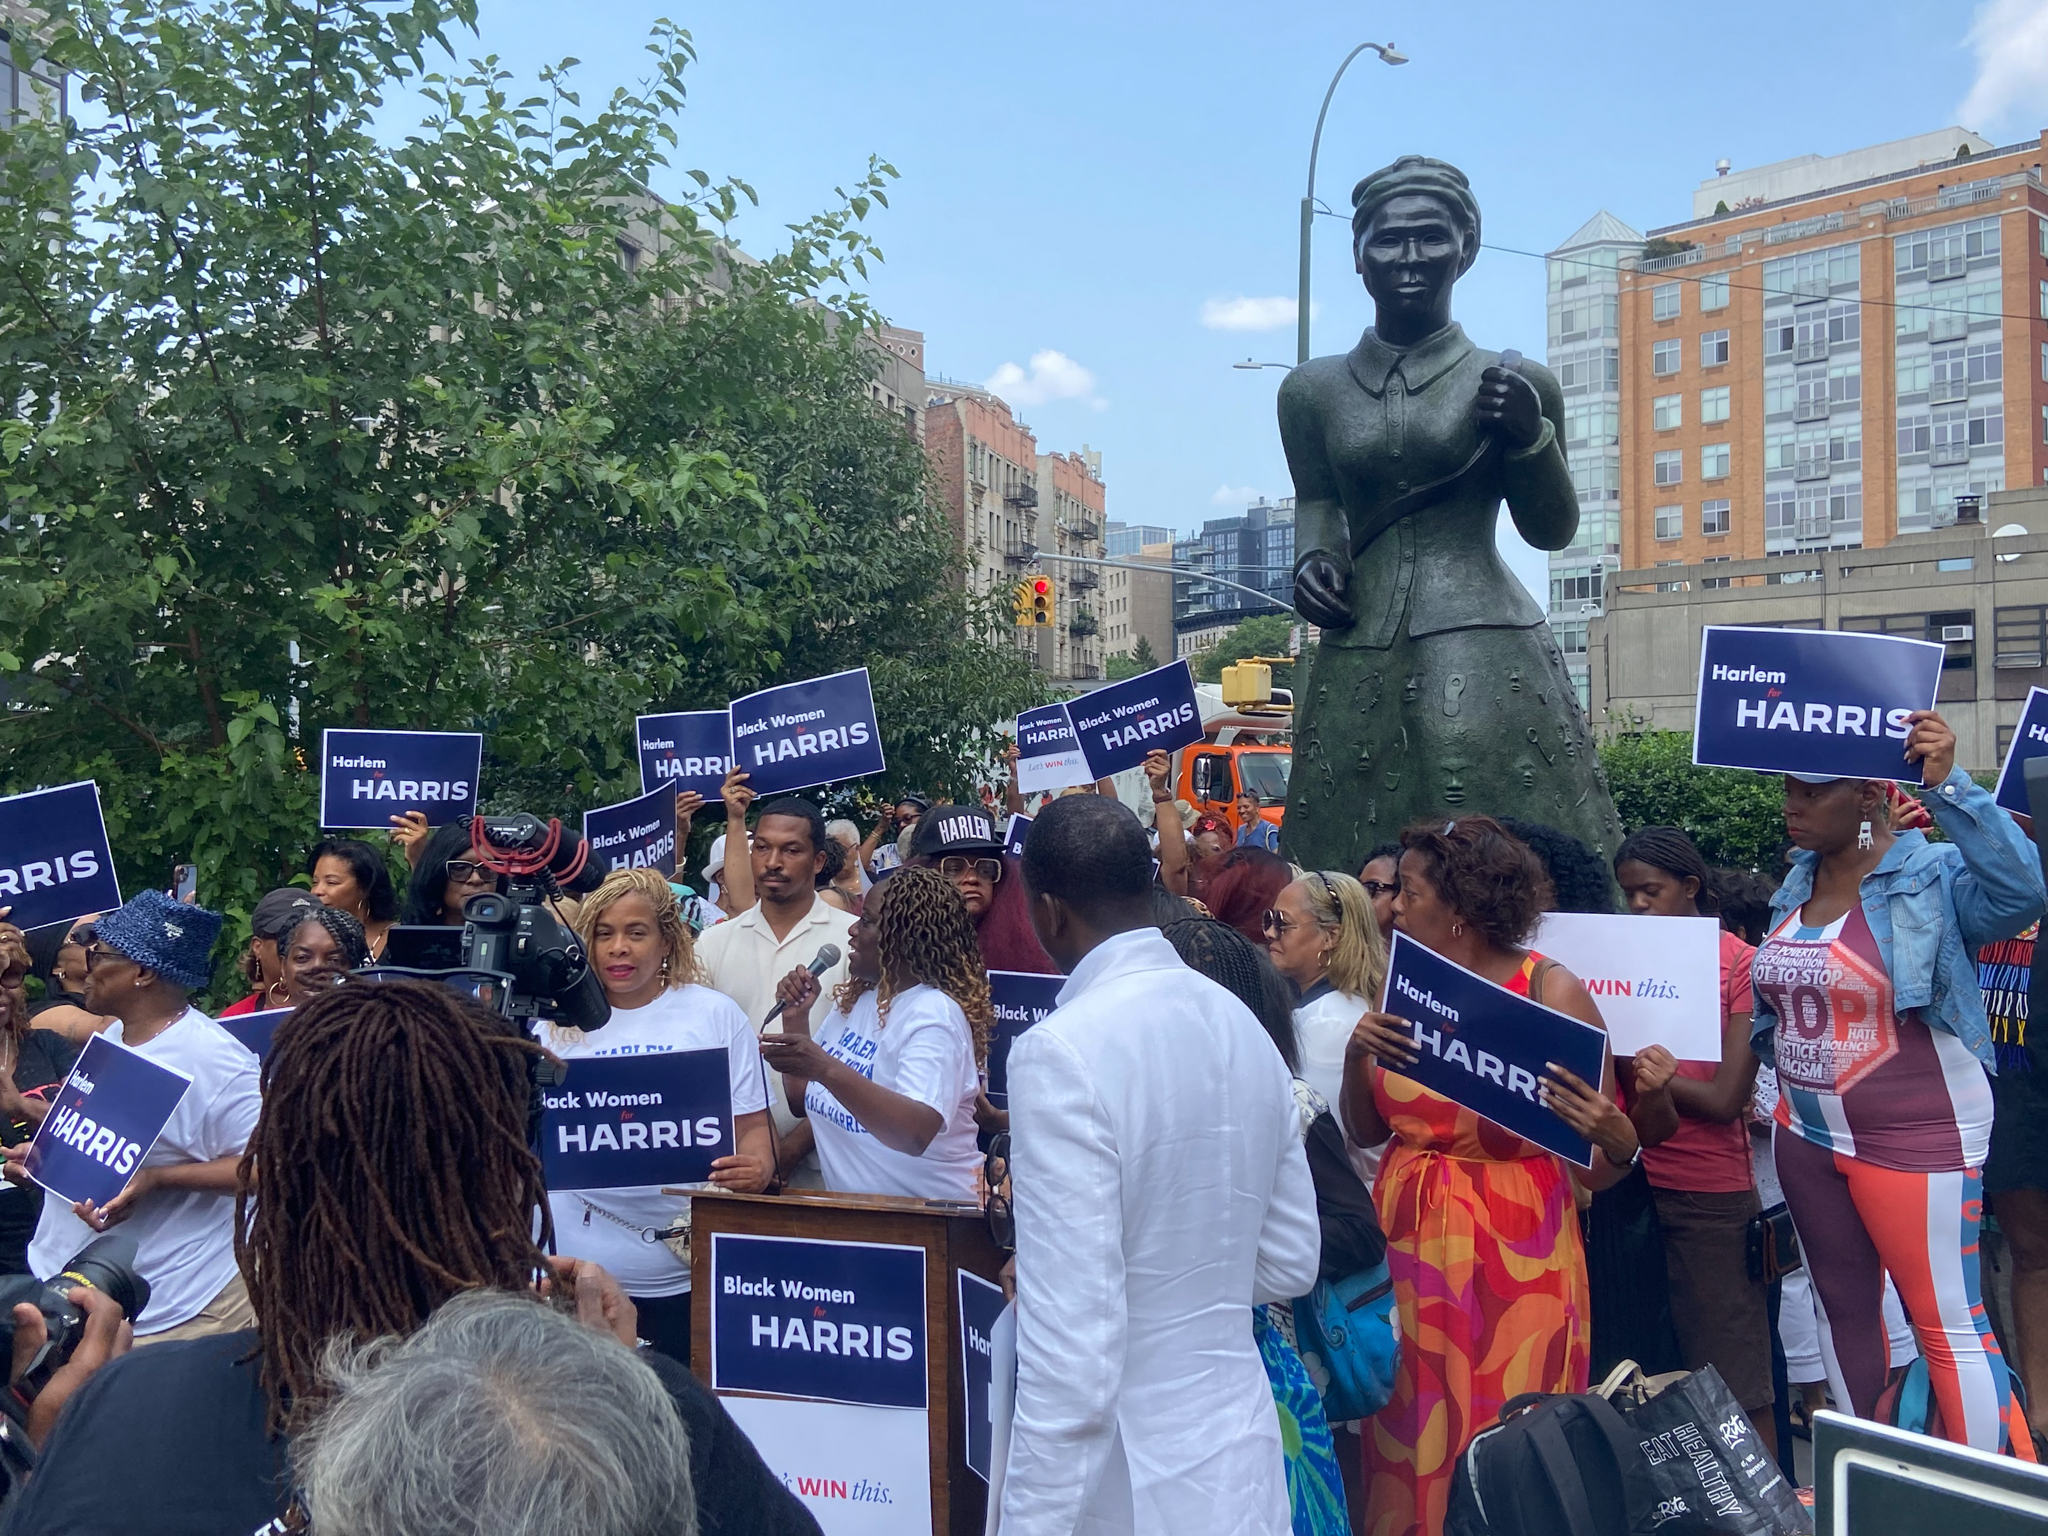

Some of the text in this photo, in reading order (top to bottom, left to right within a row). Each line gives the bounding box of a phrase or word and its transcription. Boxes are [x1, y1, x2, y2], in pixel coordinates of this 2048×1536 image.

[1712, 664, 1786, 684] Harlem
[1767, 688, 1782, 698] for
[736, 709, 826, 738] Black Women
[1035, 717, 1062, 727] Women
[1078, 697, 1160, 731] Black Women
[1736, 699, 1916, 740] HARRIS
[1026, 726, 1074, 745] HARRI
[1101, 702, 1194, 751] HARRIS
[642, 738, 675, 750] Harlem
[754, 722, 870, 766] HARRIS
[332, 755, 387, 768] Harlem
[655, 756, 731, 778] HARRI
[1028, 757, 1080, 772] Let's WIN this.
[352, 779, 469, 801] HARRIS
[592, 819, 661, 850] Black Women
[938, 815, 992, 845] HARLEM
[611, 830, 674, 872] HARRIS
[1758, 954, 1826, 968] SCRIMINATION
[1777, 946, 1821, 958] POVERTY
[1777, 966, 1798, 983] TO
[1800, 968, 1843, 986] STOP
[1837, 983, 1870, 991] INEQUITY
[1396, 973, 1460, 1023] Harlem
[1580, 978, 1680, 999] WIN this.
[993, 1004, 1029, 1021] Black
[1802, 1006, 1818, 1015] FEAR
[1848, 1028, 1878, 1040] HATE
[1819, 1050, 1860, 1058] EXPLOITATION
[1821, 1040, 1870, 1052] VIOLENCE
[1413, 1020, 1551, 1109] HARR
[1779, 1056, 1823, 1079] RACISM
[68, 1069, 95, 1096] Harlem
[542, 1091, 663, 1109] lack Women
[620, 1110, 634, 1120] for
[49, 1105, 142, 1175] HARRIS
[558, 1116, 722, 1153] HARRIS
[723, 1275, 855, 1304] Black Women
[813, 1305, 827, 1317] for
[751, 1314, 914, 1361] HARRIS
[969, 1325, 992, 1356] Har
[1639, 1432, 1680, 1466] EAT
[1672, 1421, 1743, 1517] HEALTHY
[797, 1476, 847, 1499] WIN
[852, 1478, 893, 1504] this.
